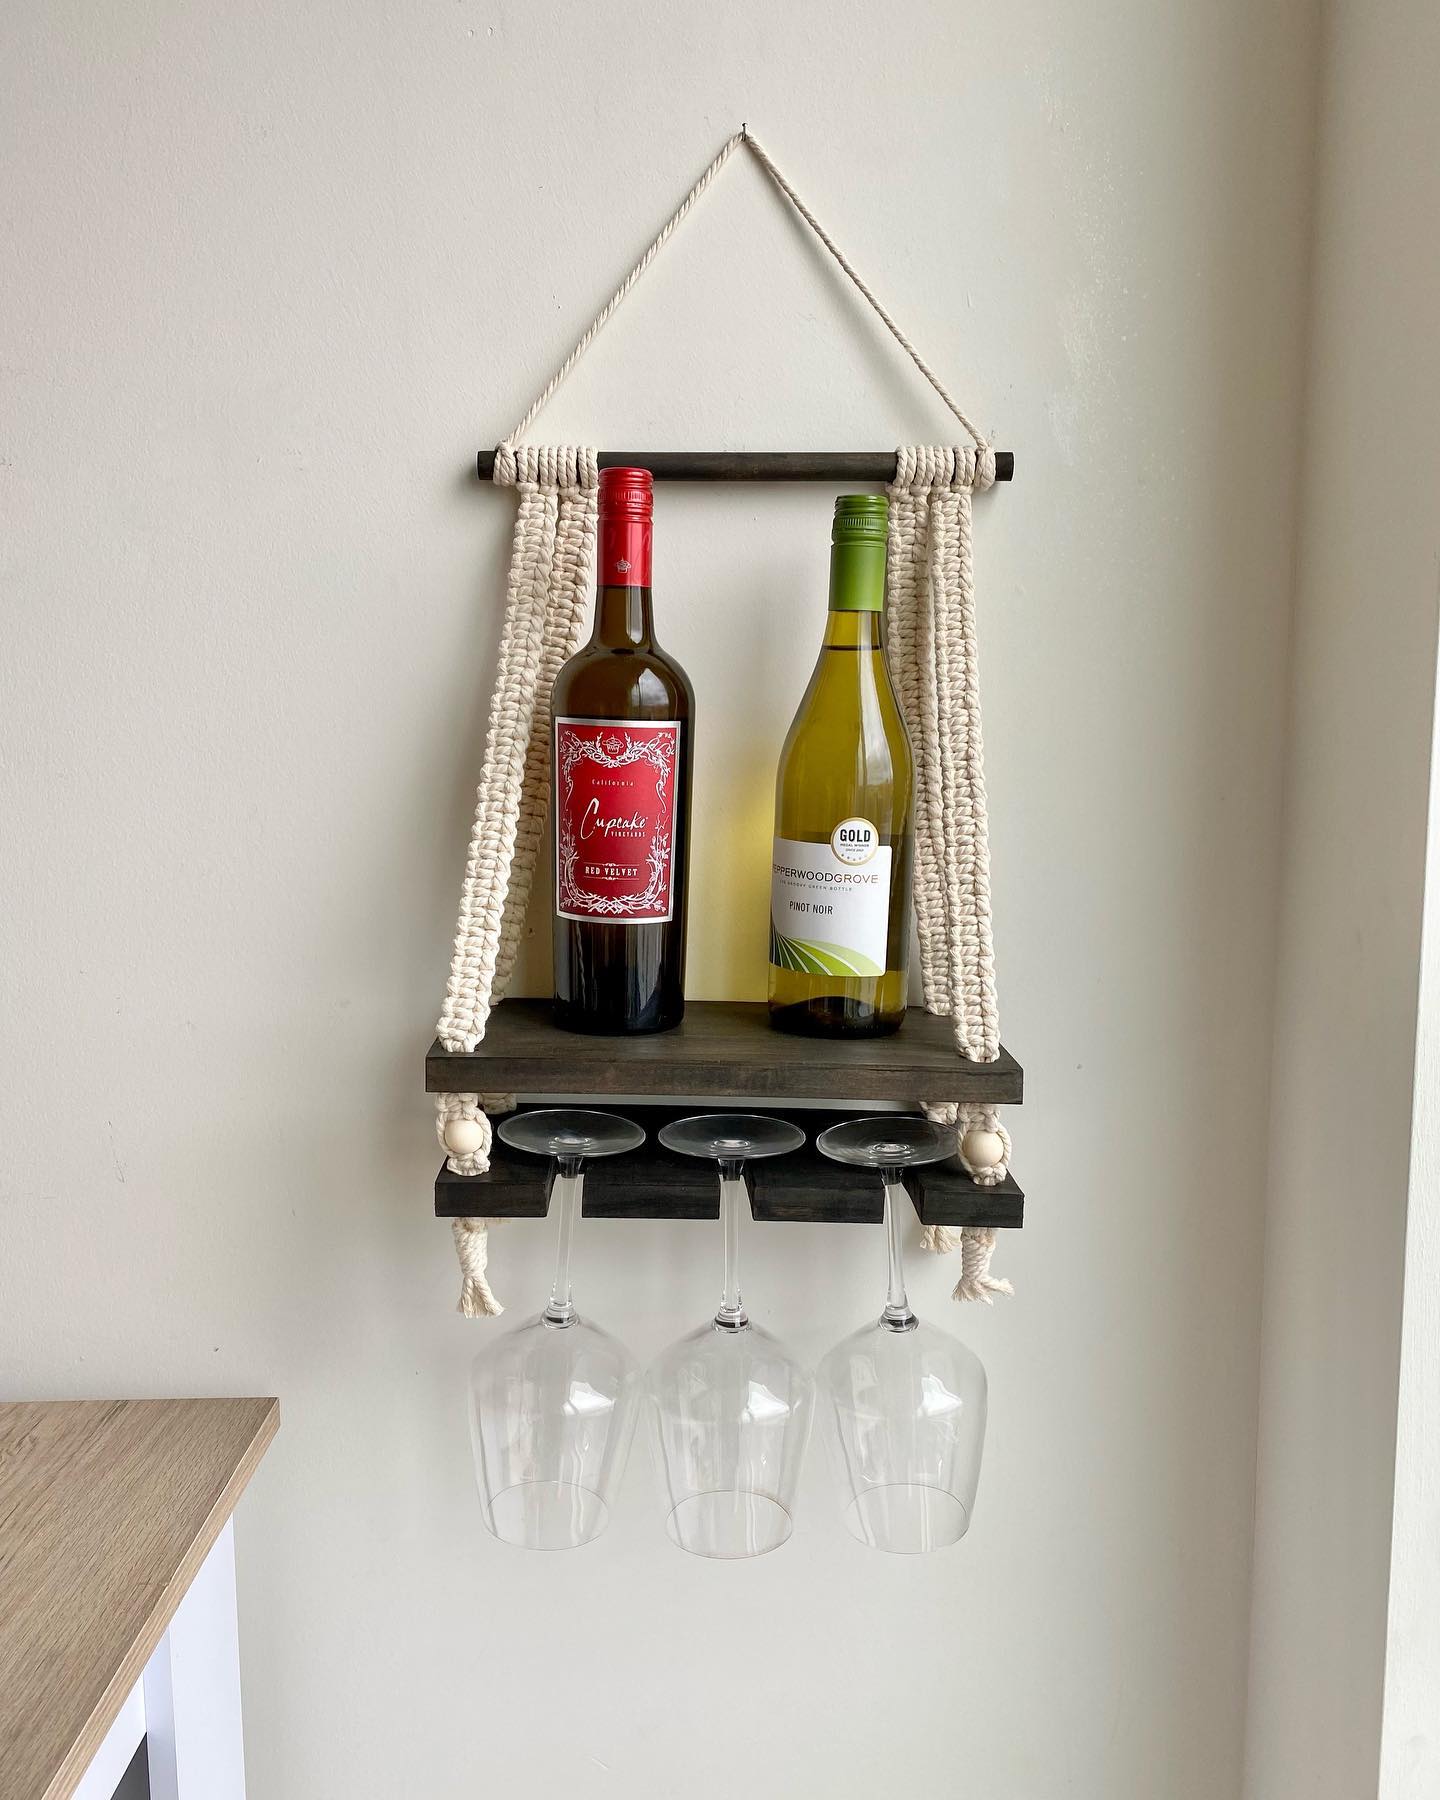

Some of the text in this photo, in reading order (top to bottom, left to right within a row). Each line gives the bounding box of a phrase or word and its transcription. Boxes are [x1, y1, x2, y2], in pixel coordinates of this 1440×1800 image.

[581, 797, 646, 840] Cupcake
[840, 828, 871, 842] GOLD
[585, 866, 638, 876] RED VELVET
[773, 864, 879, 884] EPPERWOODGROVE
[789, 900, 833, 915] PINOT NOIR
